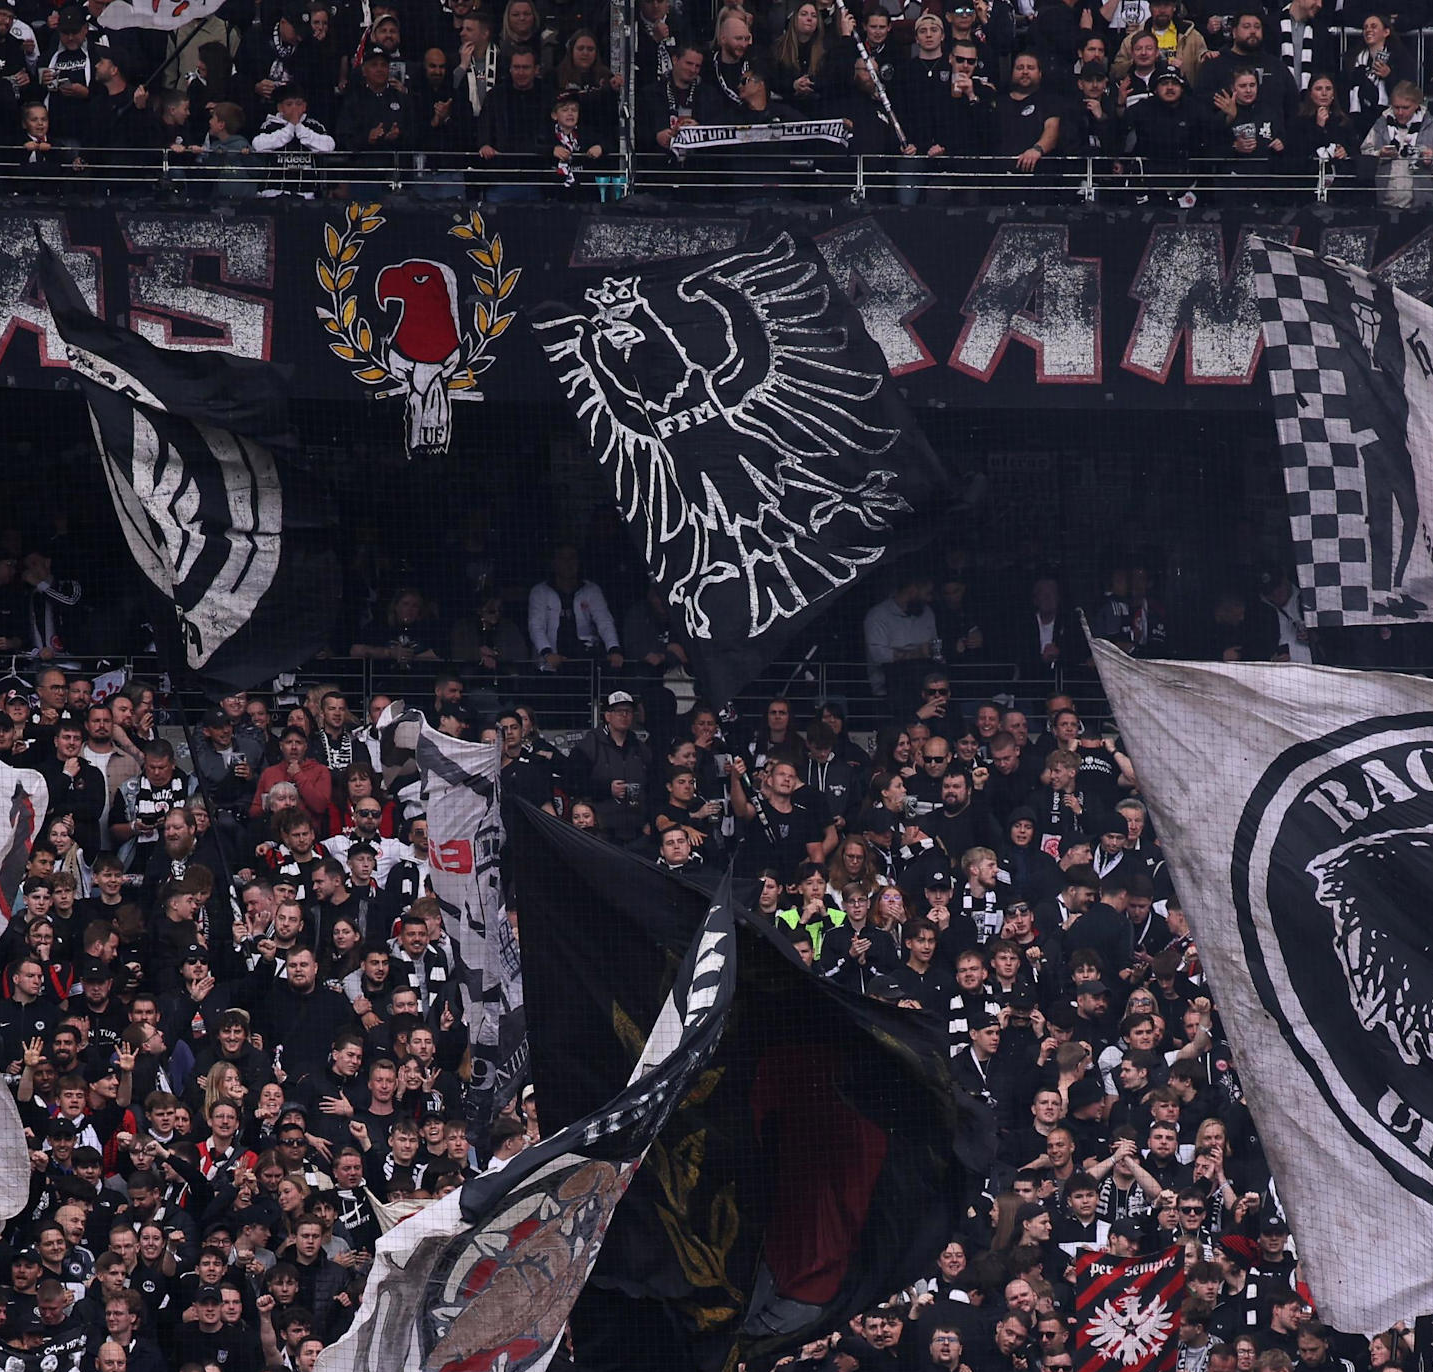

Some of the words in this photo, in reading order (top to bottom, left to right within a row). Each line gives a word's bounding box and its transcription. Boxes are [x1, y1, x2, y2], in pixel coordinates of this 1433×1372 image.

[657, 401, 715, 440] FFM
[1089, 1262, 1114, 1278] per
[1124, 1256, 1177, 1278] sempre
